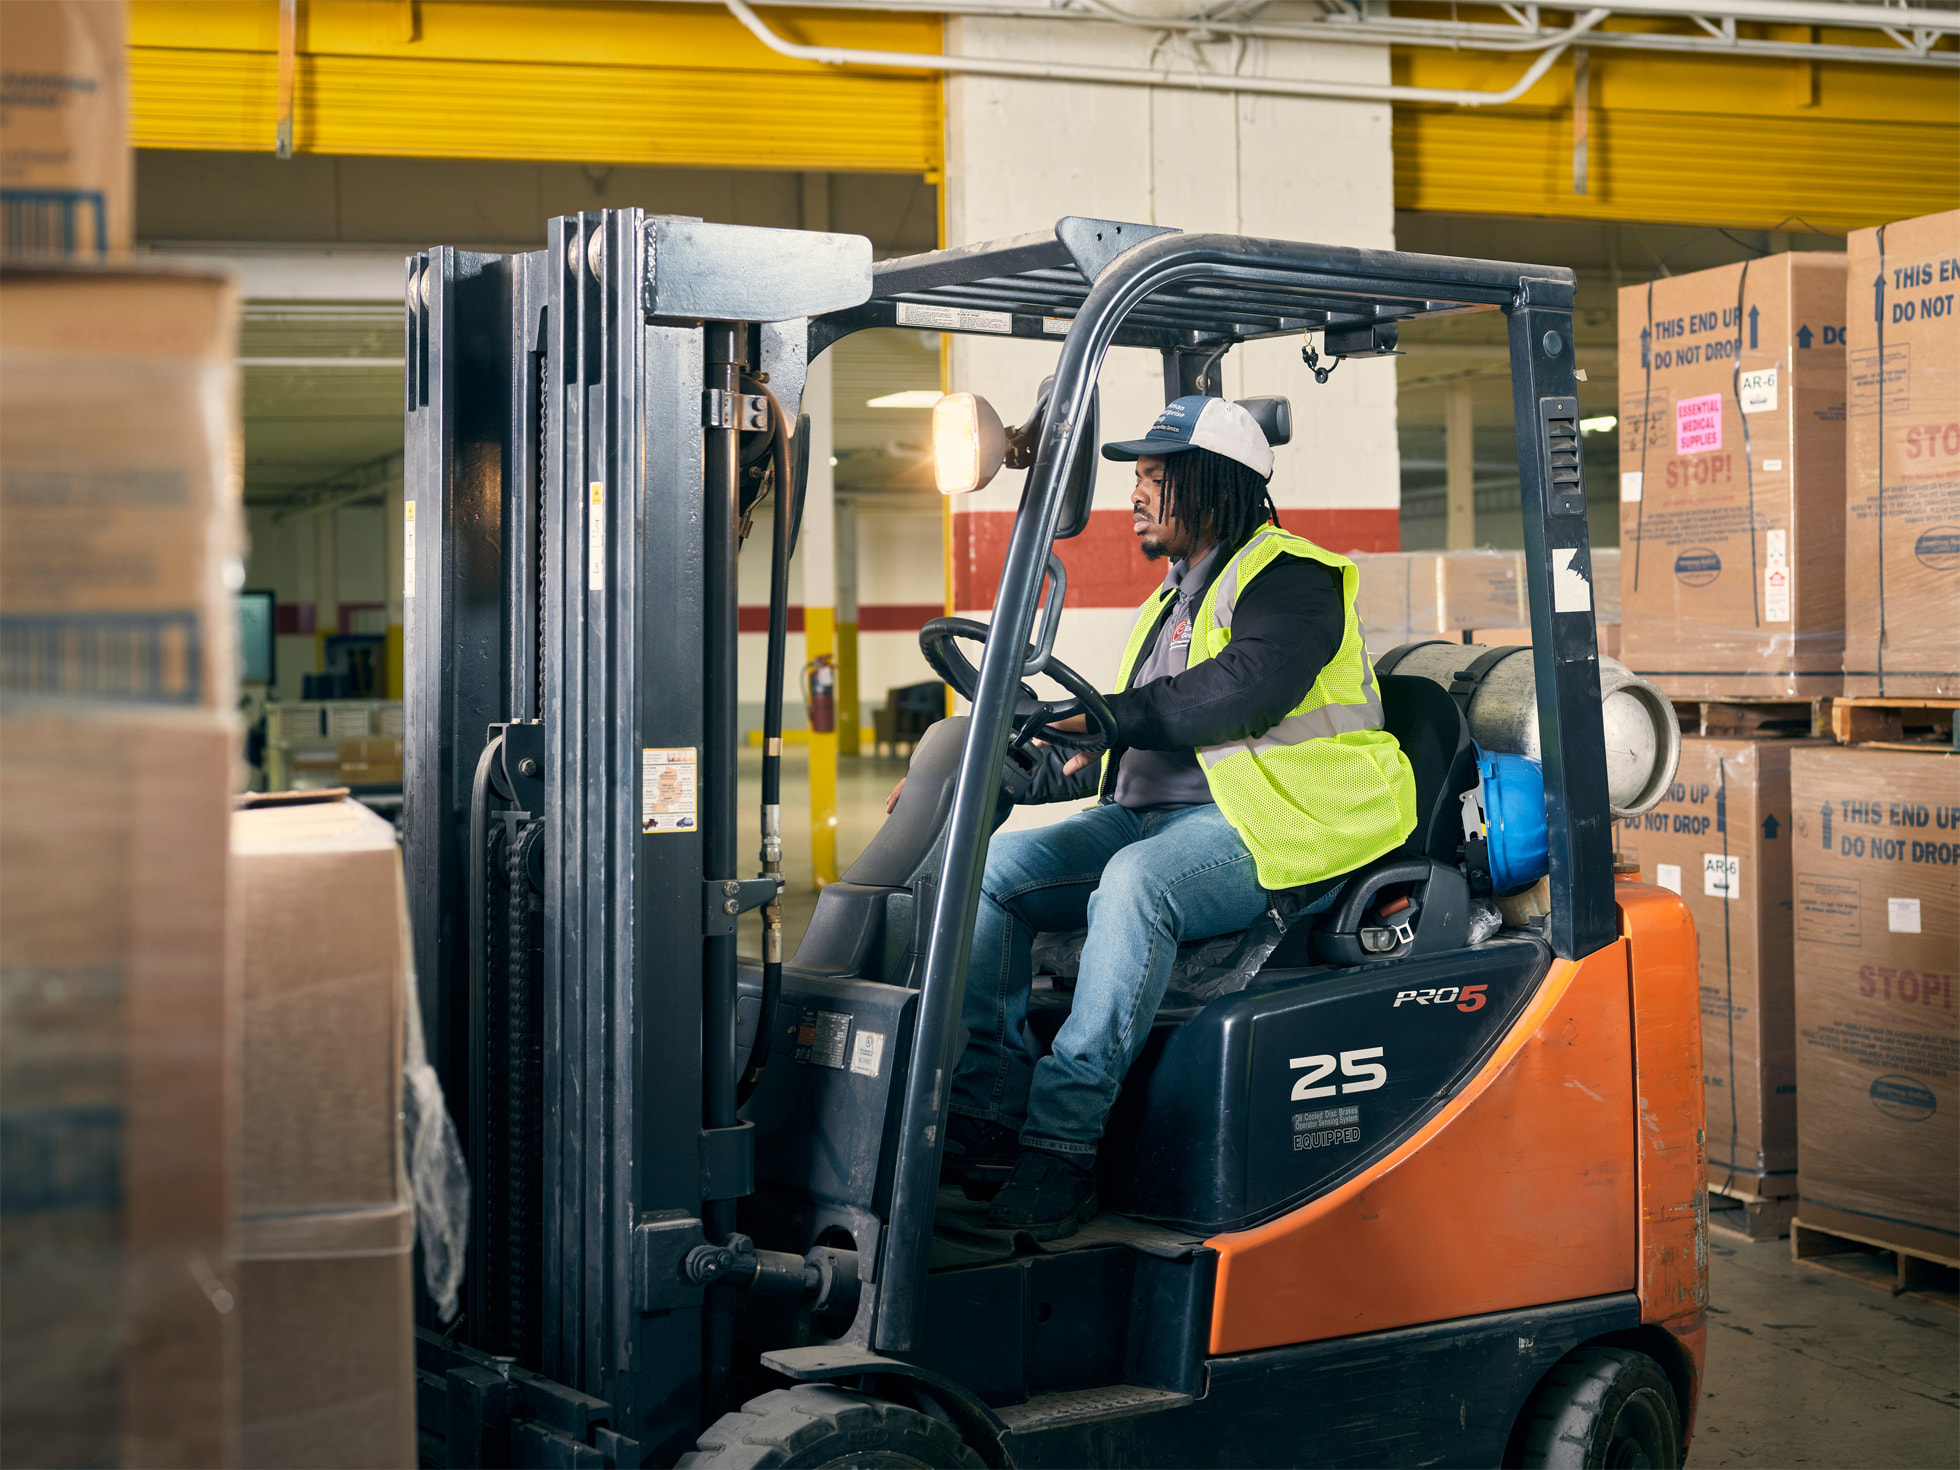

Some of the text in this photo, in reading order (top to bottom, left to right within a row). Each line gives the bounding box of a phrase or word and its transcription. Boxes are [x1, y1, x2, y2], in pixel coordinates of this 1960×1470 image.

[1894, 263, 1933, 290] THIS
[1893, 294, 1954, 324] DO NOT
[1655, 318, 1684, 341] THIS
[1690, 312, 1717, 334] END
[1654, 352, 1672, 370] DO
[1676, 346, 1701, 366] NOT
[1743, 374, 1775, 390] AR-6
[1678, 400, 1719, 418] ESSENTIAL
[1682, 418, 1715, 433] MEDICAL
[1681, 433, 1717, 449] SUPPLIES
[1666, 454, 1732, 489] STOP!
[1690, 784, 1710, 804] UP
[1624, 813, 1710, 835] DO NOT DROP
[1841, 800, 1882, 824] THIS
[1890, 803, 1929, 827] END
[1841, 835, 1865, 858] DO
[1871, 837, 1905, 861] NOT
[1859, 964, 1951, 1009] STOP!
[1289, 1047, 1387, 1101] 25
[1296, 1115, 1358, 1130] Operator Sensing System
[1304, 1112, 1323, 1121] Cooled
[1325, 1109, 1338, 1118] Disc
[1339, 1107, 1358, 1116] Brakes
[1293, 1127, 1360, 1150] EQUIPPED
